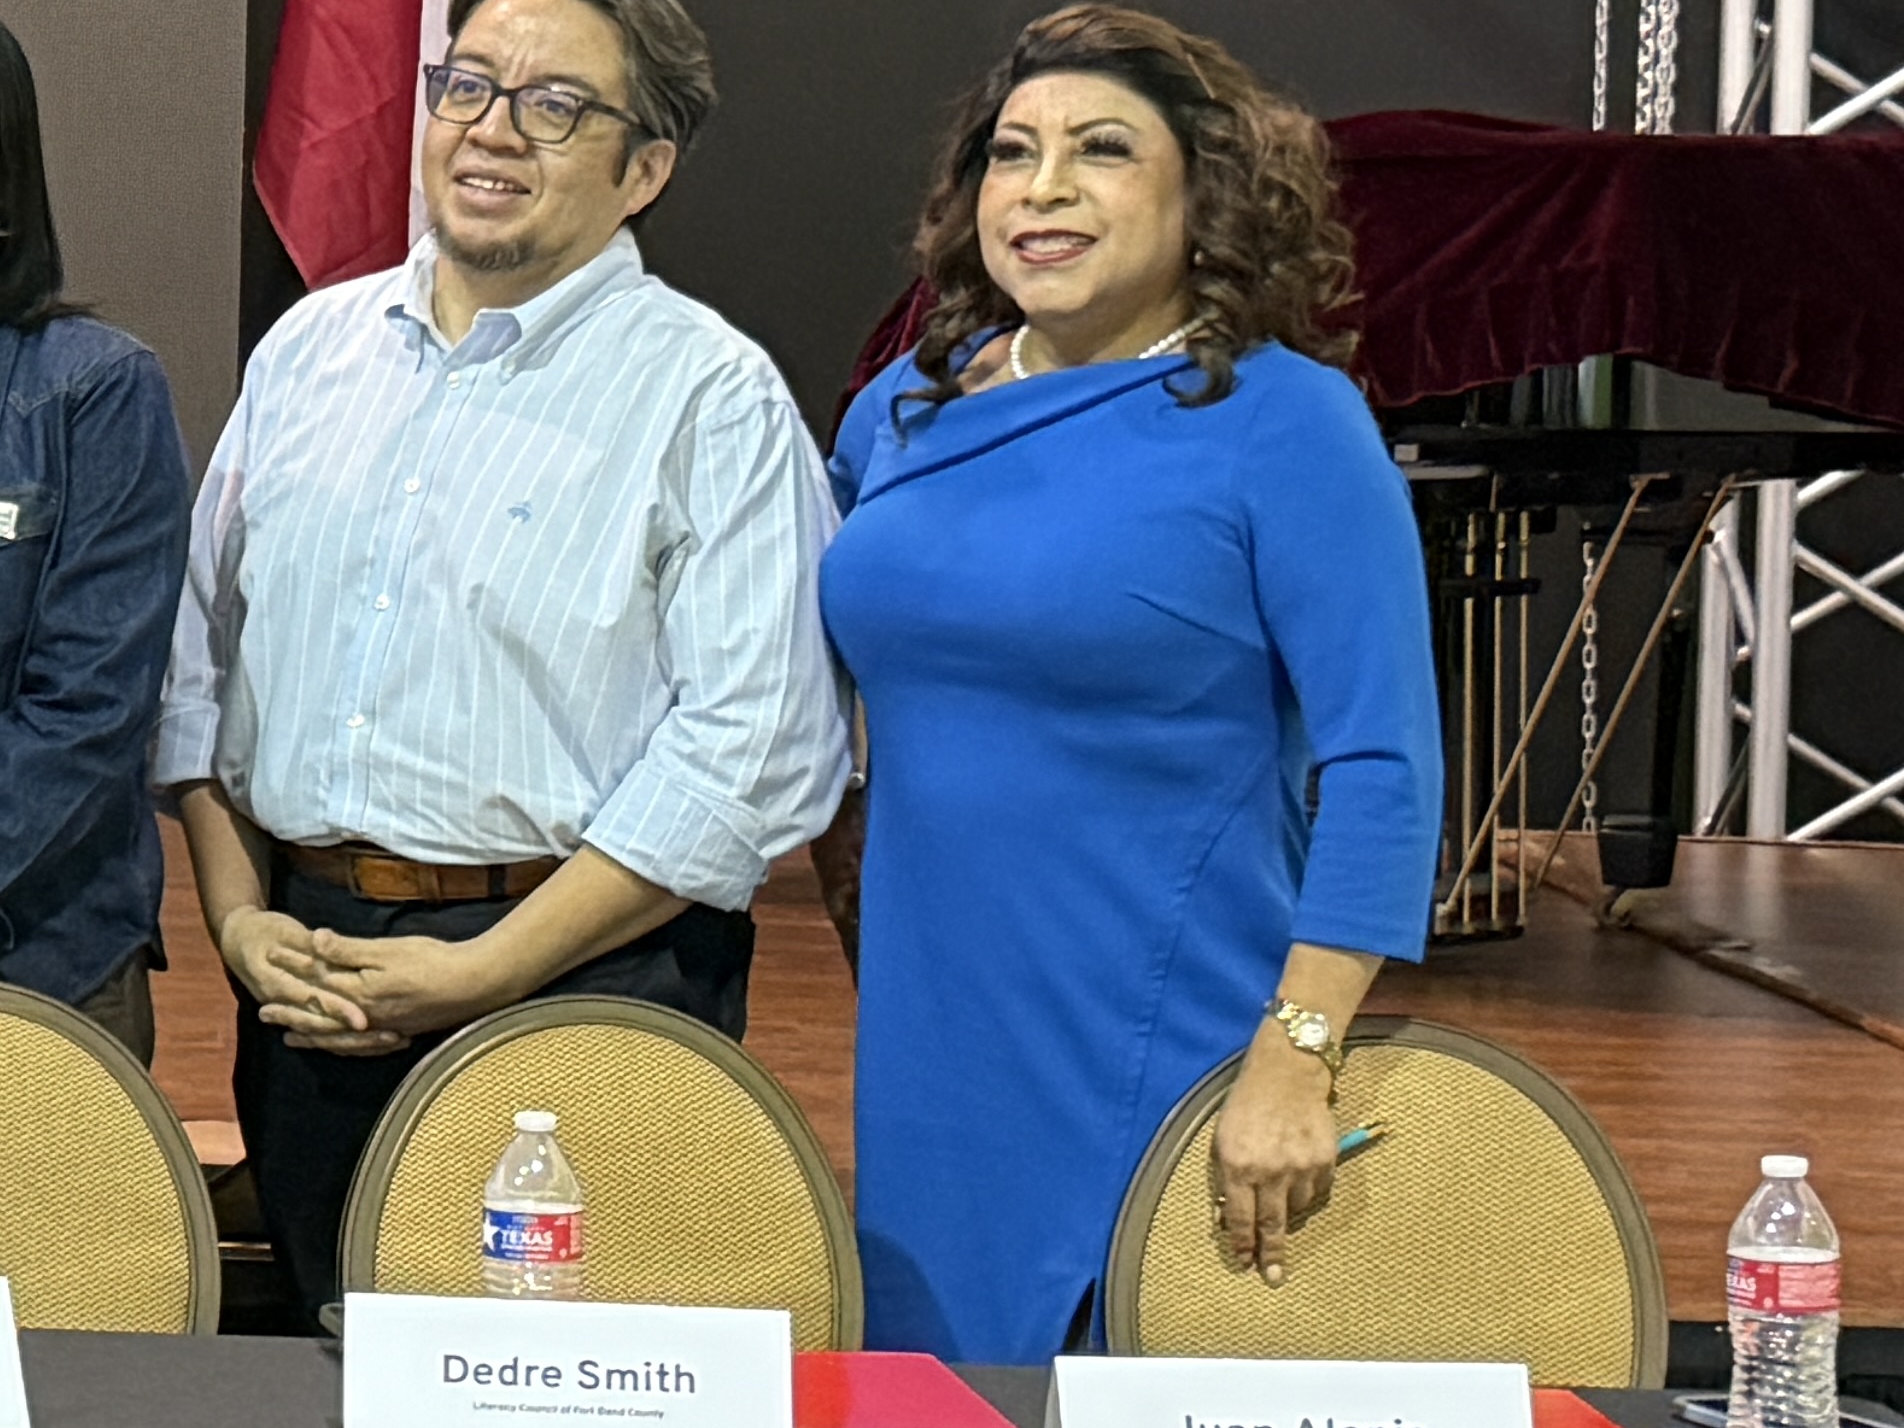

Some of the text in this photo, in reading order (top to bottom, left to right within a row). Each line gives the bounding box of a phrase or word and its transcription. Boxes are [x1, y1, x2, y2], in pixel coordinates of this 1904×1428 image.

[501, 1229, 553, 1245] TEXAS
[1726, 1273, 1757, 1292] EXAS
[443, 1354, 695, 1393] Dedre Smith
